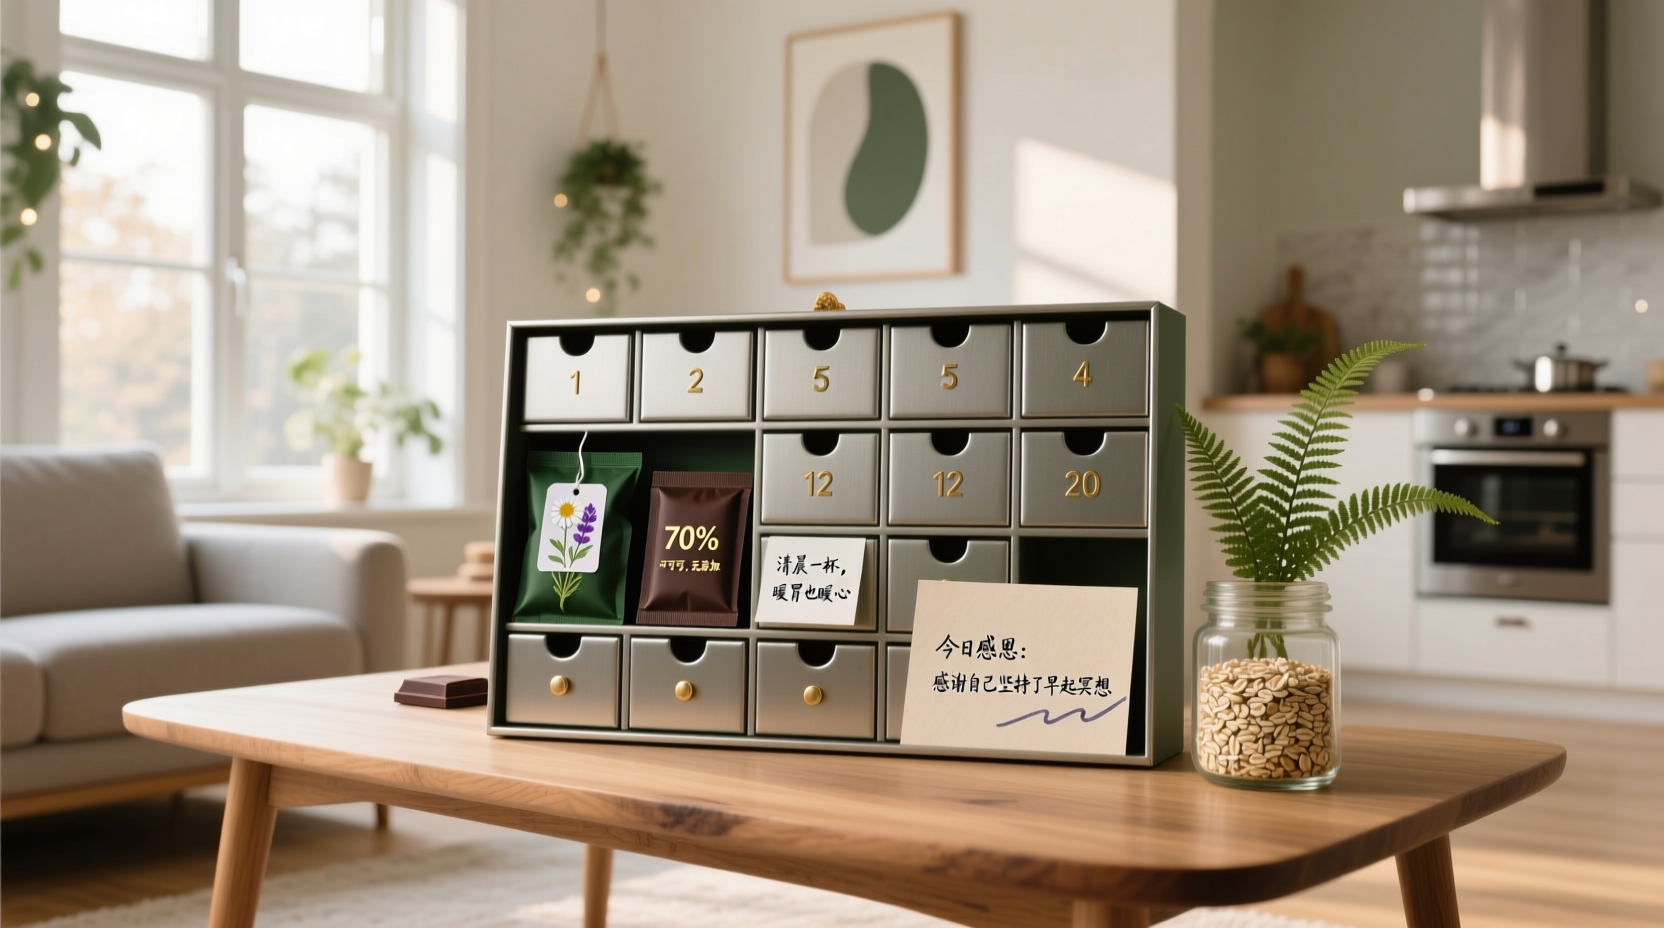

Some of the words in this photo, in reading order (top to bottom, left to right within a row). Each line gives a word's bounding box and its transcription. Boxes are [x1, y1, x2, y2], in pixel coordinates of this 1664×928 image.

[570, 370, 580, 395] 1
[687, 368, 704, 394] 2
[812, 365, 830, 393] 5
[940, 363, 959, 390] 5
[1072, 360, 1092, 388] 4
[804, 471, 834, 498] 12
[933, 471, 964, 498] 12
[1064, 469, 1101, 499] 20
[664, 525, 719, 551] 70%
